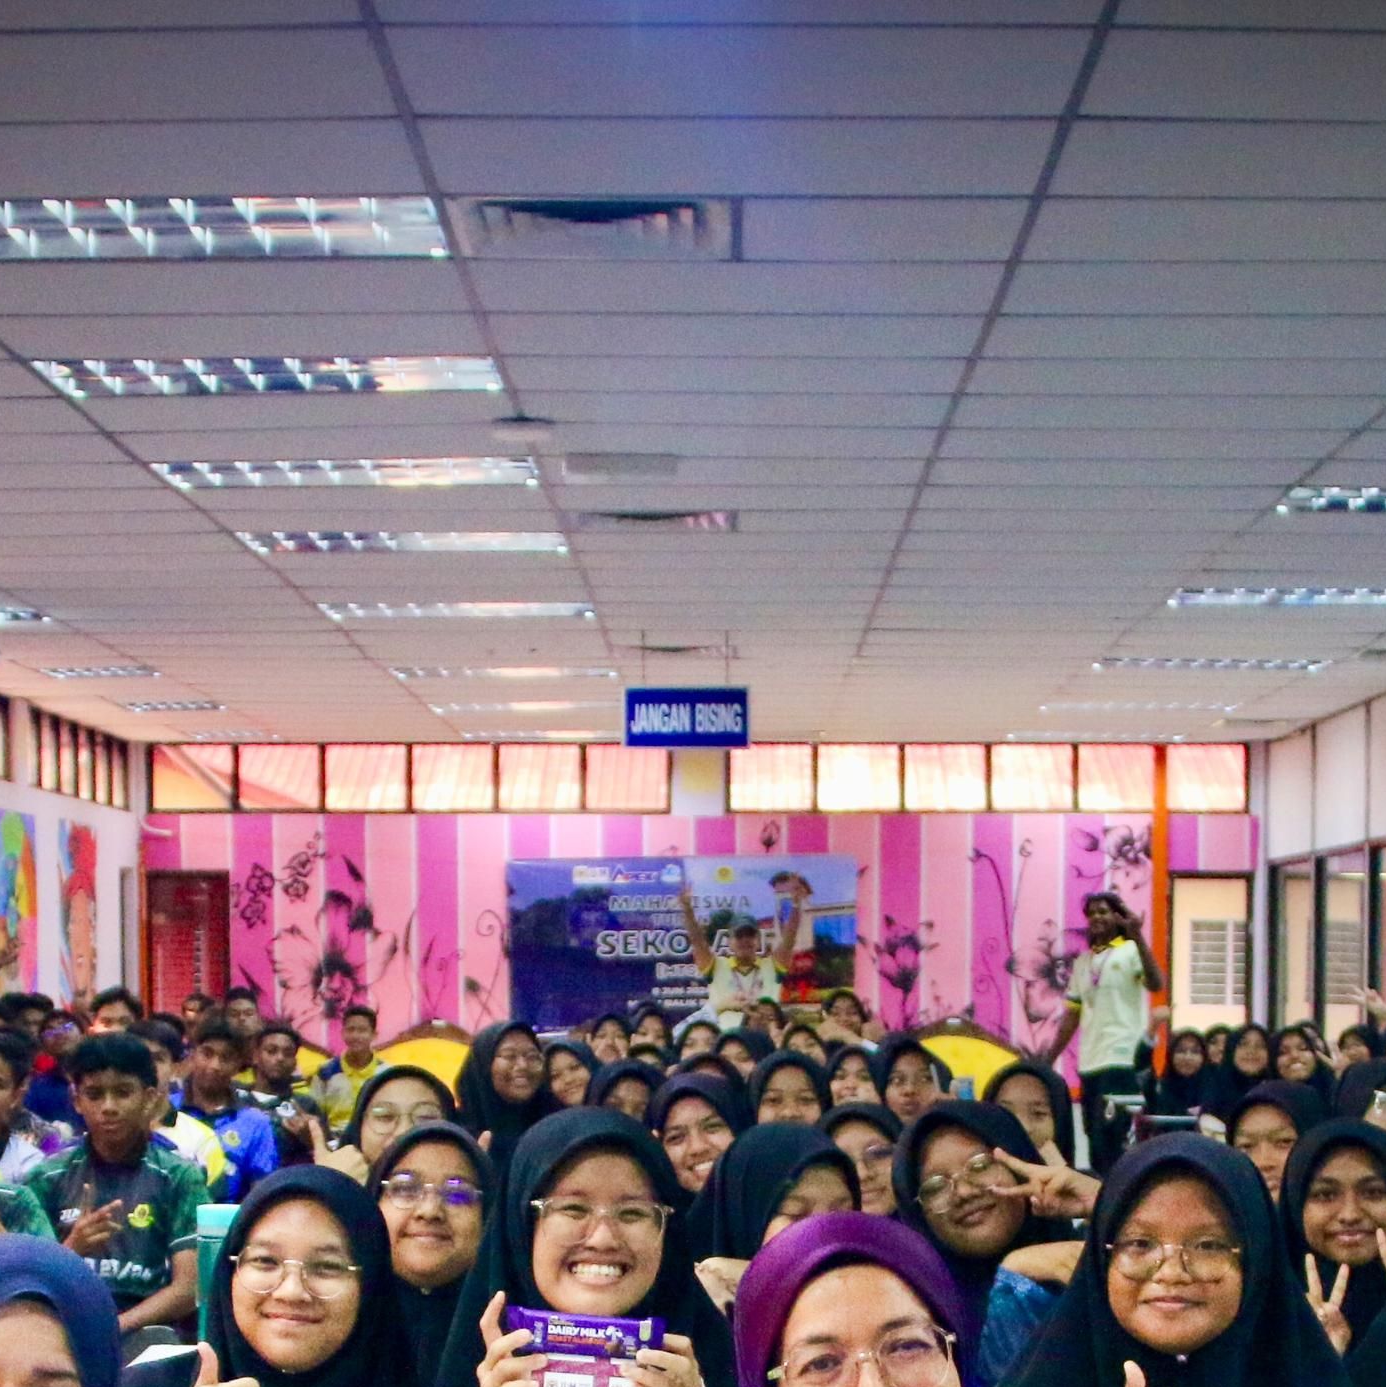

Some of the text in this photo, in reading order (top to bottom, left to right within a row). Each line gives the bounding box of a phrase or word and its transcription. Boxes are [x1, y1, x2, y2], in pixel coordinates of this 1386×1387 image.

[630, 702, 743, 734] JANGAN BISING
[608, 895, 751, 912] MAHAISWA
[596, 929, 767, 959] SEKOA
[548, 1325, 580, 1336] DAIRY
[580, 1327, 606, 1338] MILK
